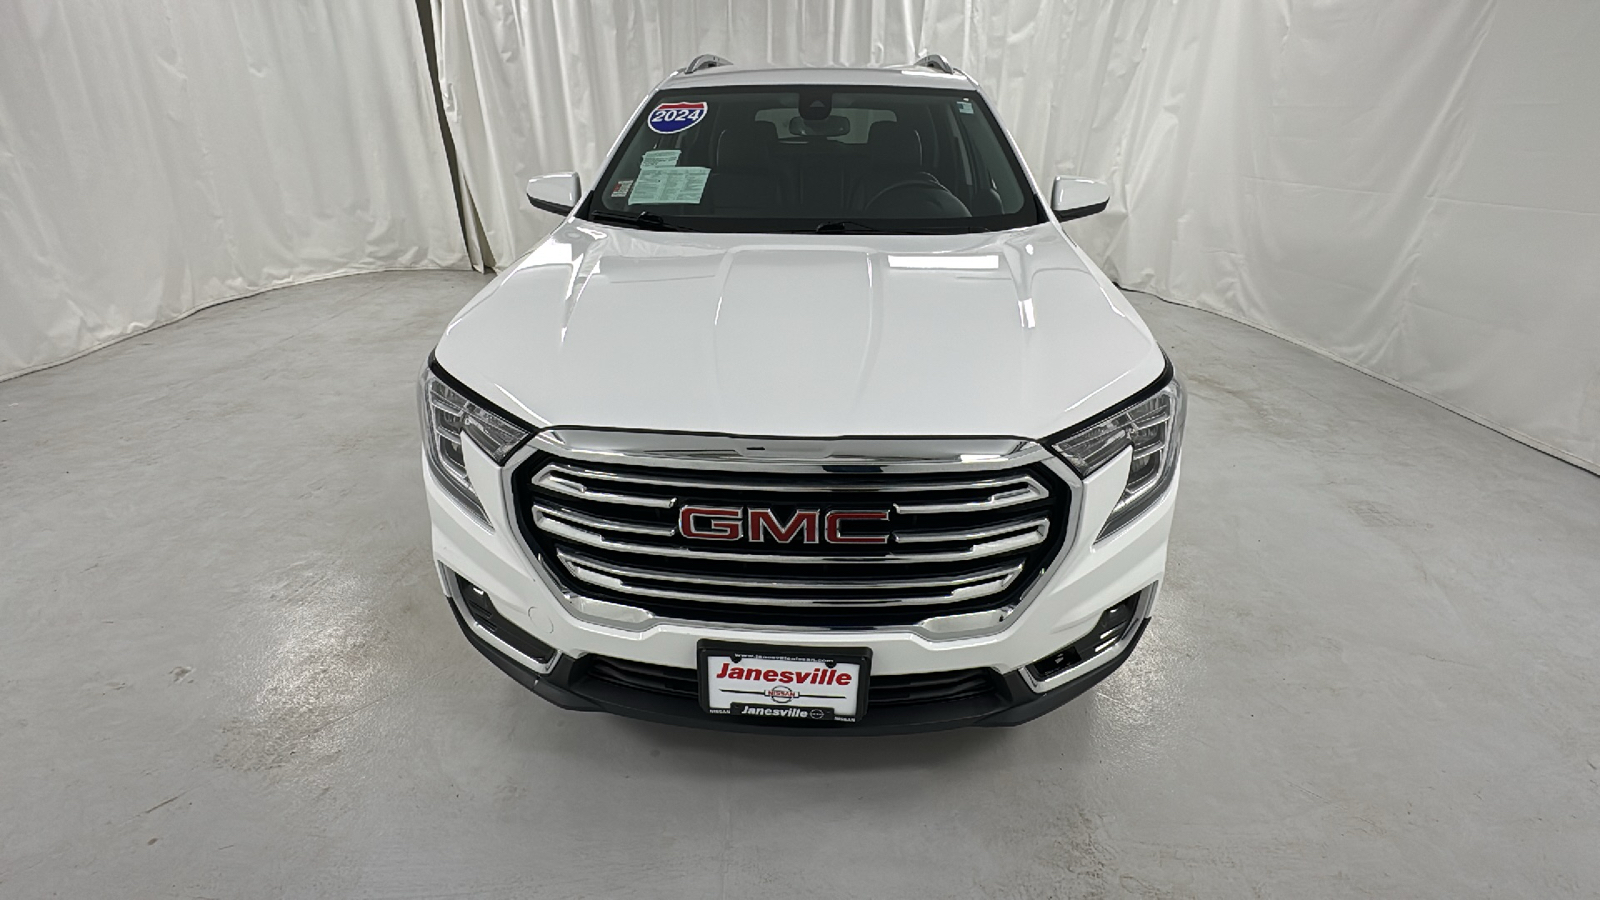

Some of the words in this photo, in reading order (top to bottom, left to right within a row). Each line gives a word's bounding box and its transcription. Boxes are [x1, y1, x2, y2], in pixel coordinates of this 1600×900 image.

[651, 110, 701, 123] 2024
[679, 504, 890, 544] GMC
[716, 662, 852, 686] Janesville
[768, 690, 796, 698] NISSAN
[741, 705, 808, 718] Janesville
